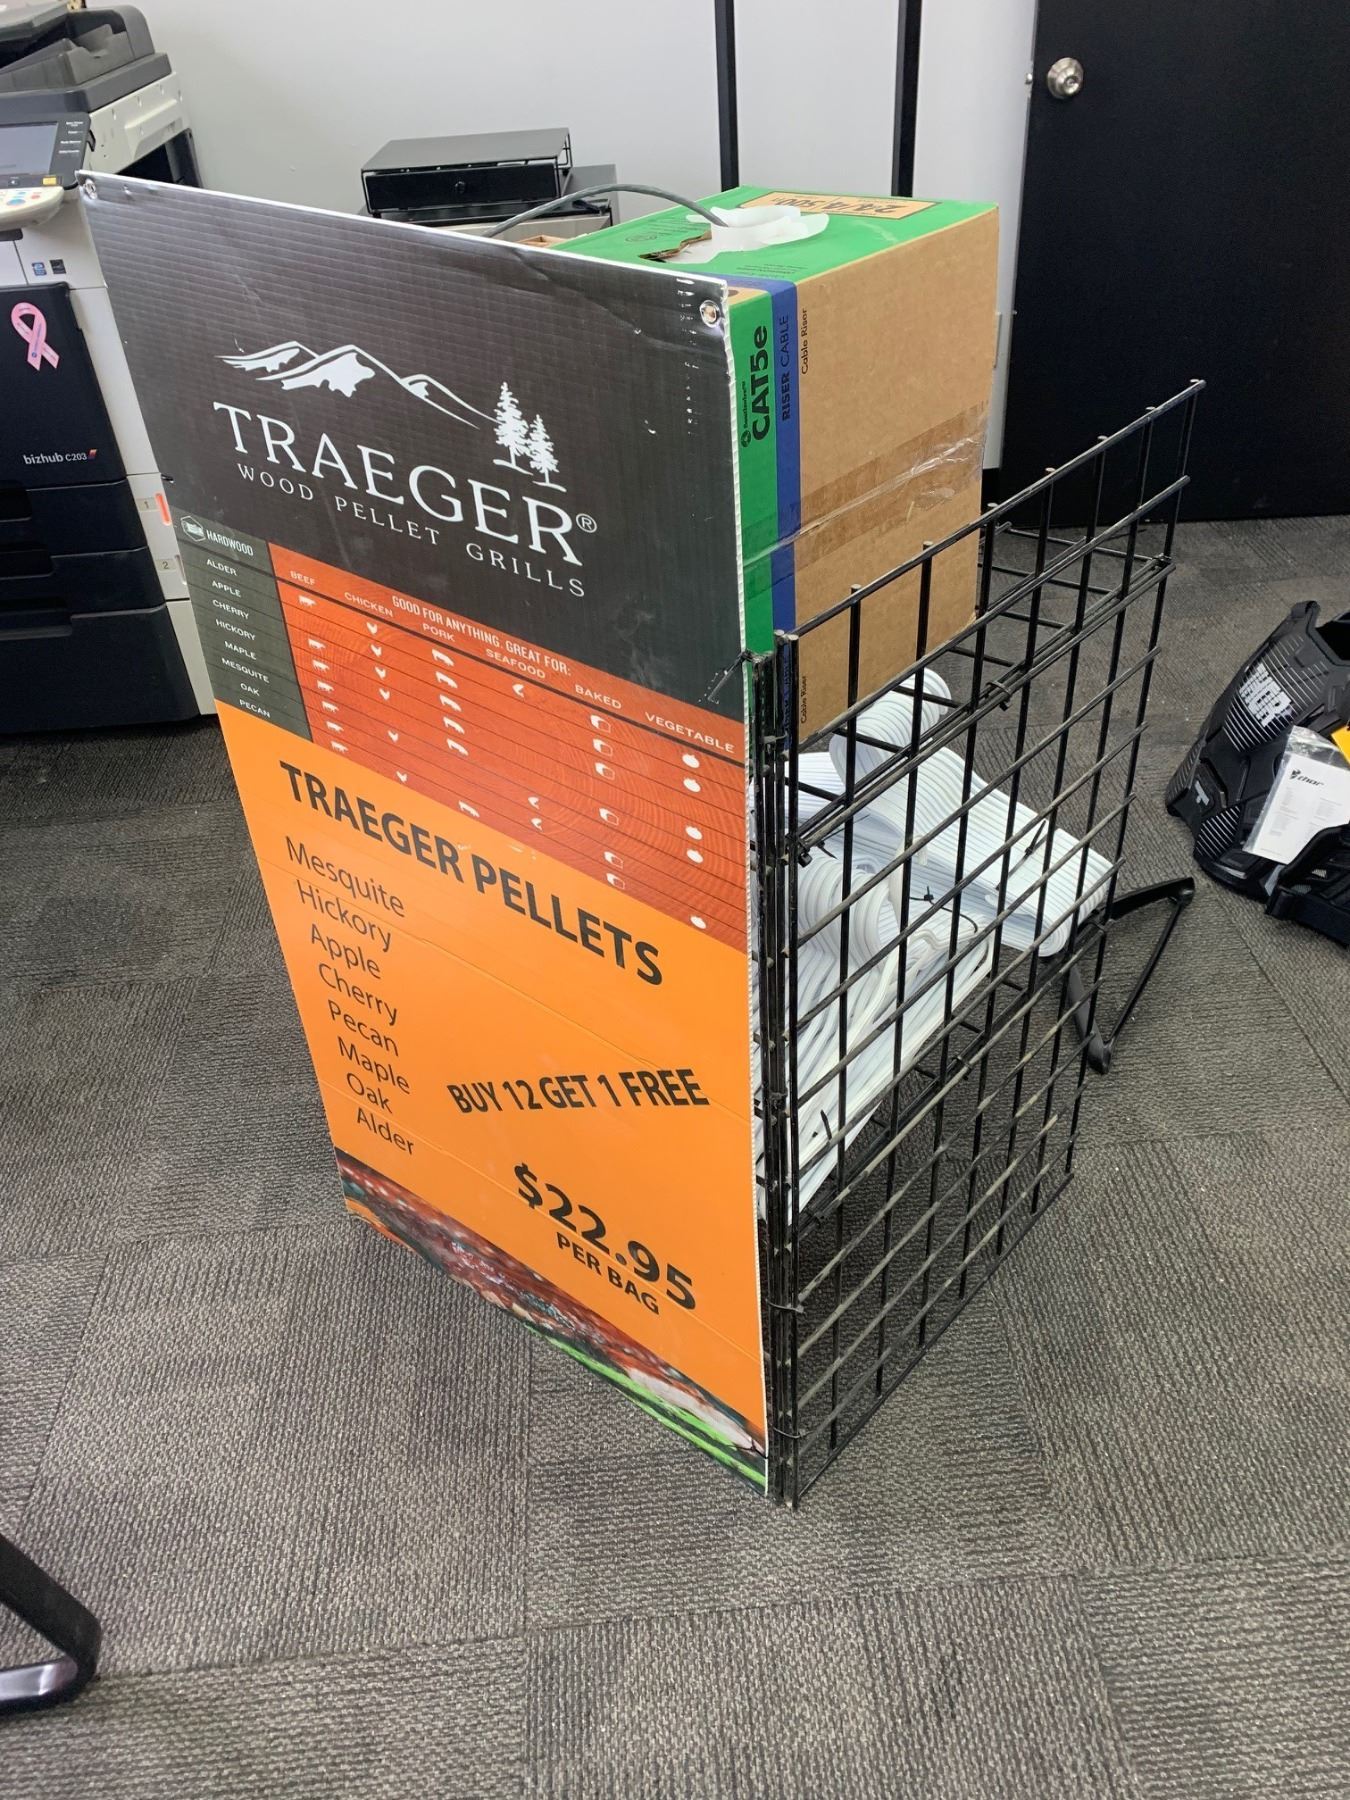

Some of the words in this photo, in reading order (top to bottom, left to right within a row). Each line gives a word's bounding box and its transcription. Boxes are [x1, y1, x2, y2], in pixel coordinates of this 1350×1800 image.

[780, 315, 790, 370] CABLE
[752, 325, 768, 441] CAT5e
[782, 372, 791, 421] RISER
[23, 452, 64, 465] bizhub
[65, 452, 87, 463] C203
[206, 529, 254, 557] HARDWOOD
[237, 462, 314, 501] WOOD
[335, 494, 440, 546] PELLET
[466, 542, 585, 597] GRILLS
[162, 561, 170, 570] 2
[206, 558, 238, 577] ALDER
[211, 579, 242, 598] APPLE
[212, 599, 250, 620] CHERRY
[215, 618, 256, 641] HICKORY
[224, 640, 257, 661] MAPLE
[392, 595, 421, 616] GOOD
[422, 607, 444, 625] FOR
[505, 640, 541, 664] GREAT
[544, 655, 571, 676] FOR:
[221, 657, 270, 684] MESQUITE
[290, 570, 316, 586] BEEF
[344, 591, 394, 618] CHICKEN
[422, 623, 456, 643] PORK
[486, 648, 546, 679] SEAFOOD
[575, 684, 622, 710] BAKED
[645, 711, 735, 754] VEGETABLE
[239, 698, 271, 719] PECAN
[240, 682, 260, 697] OAK
[279, 760, 465, 883] TRAEGER
[470, 852, 664, 986] PELLETS
[285, 835, 406, 919] Mesquite
[296, 879, 393, 954] Hickory
[310, 923, 382, 980] Apple
[317, 963, 398, 1027] Cherry
[327, 1000, 400, 1057] Pecan
[337, 1036, 411, 1096] Maple
[447, 1081, 503, 1114] BUY
[502, 1079, 543, 1112] 12
[540, 1074, 598, 1110] GET
[598, 1073, 622, 1108] 1
[620, 1068, 711, 1107] FREE
[346, 1072, 393, 1115] Oak
[356, 1107, 415, 1157] Alder
[514, 1162, 697, 1311] $22.95
[556, 1231, 602, 1277] PER
[607, 1269, 660, 1316] BAG
